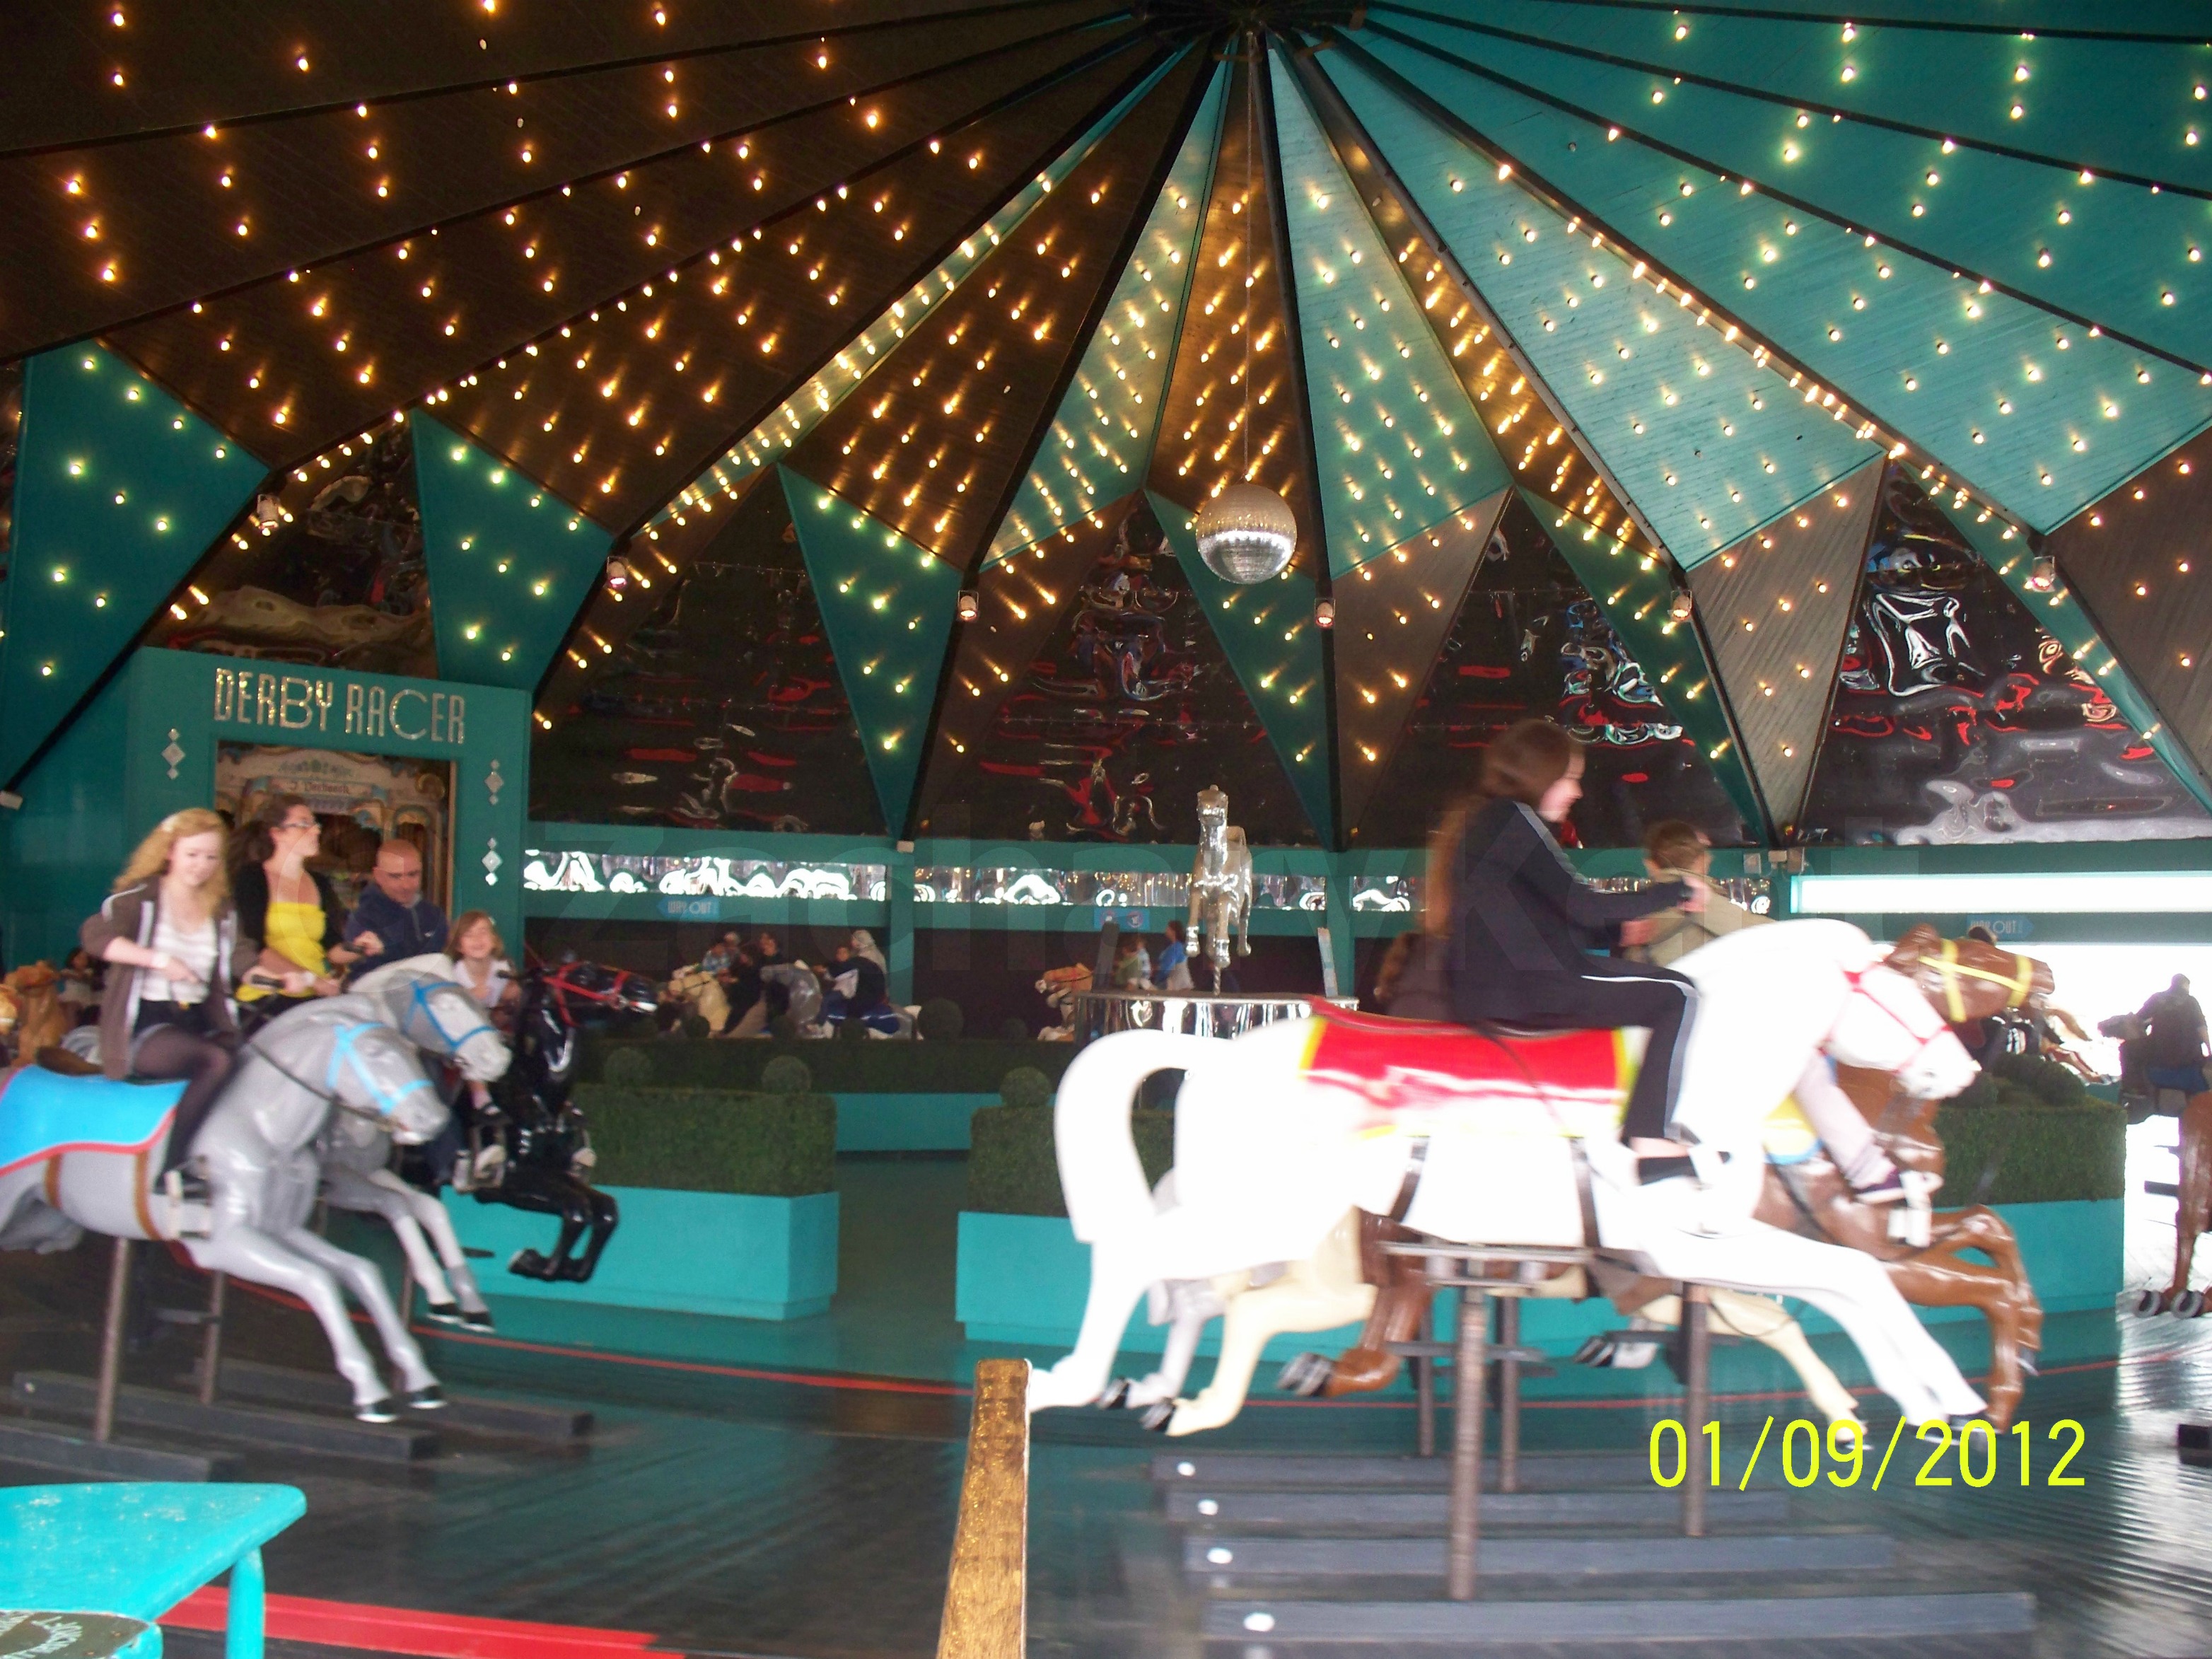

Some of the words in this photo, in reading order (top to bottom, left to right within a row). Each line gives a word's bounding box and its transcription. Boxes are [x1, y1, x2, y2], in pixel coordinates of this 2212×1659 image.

[214, 668, 332, 731] DERBY
[345, 683, 465, 744] RACER
[1993, 920, 2018, 934] OUT
